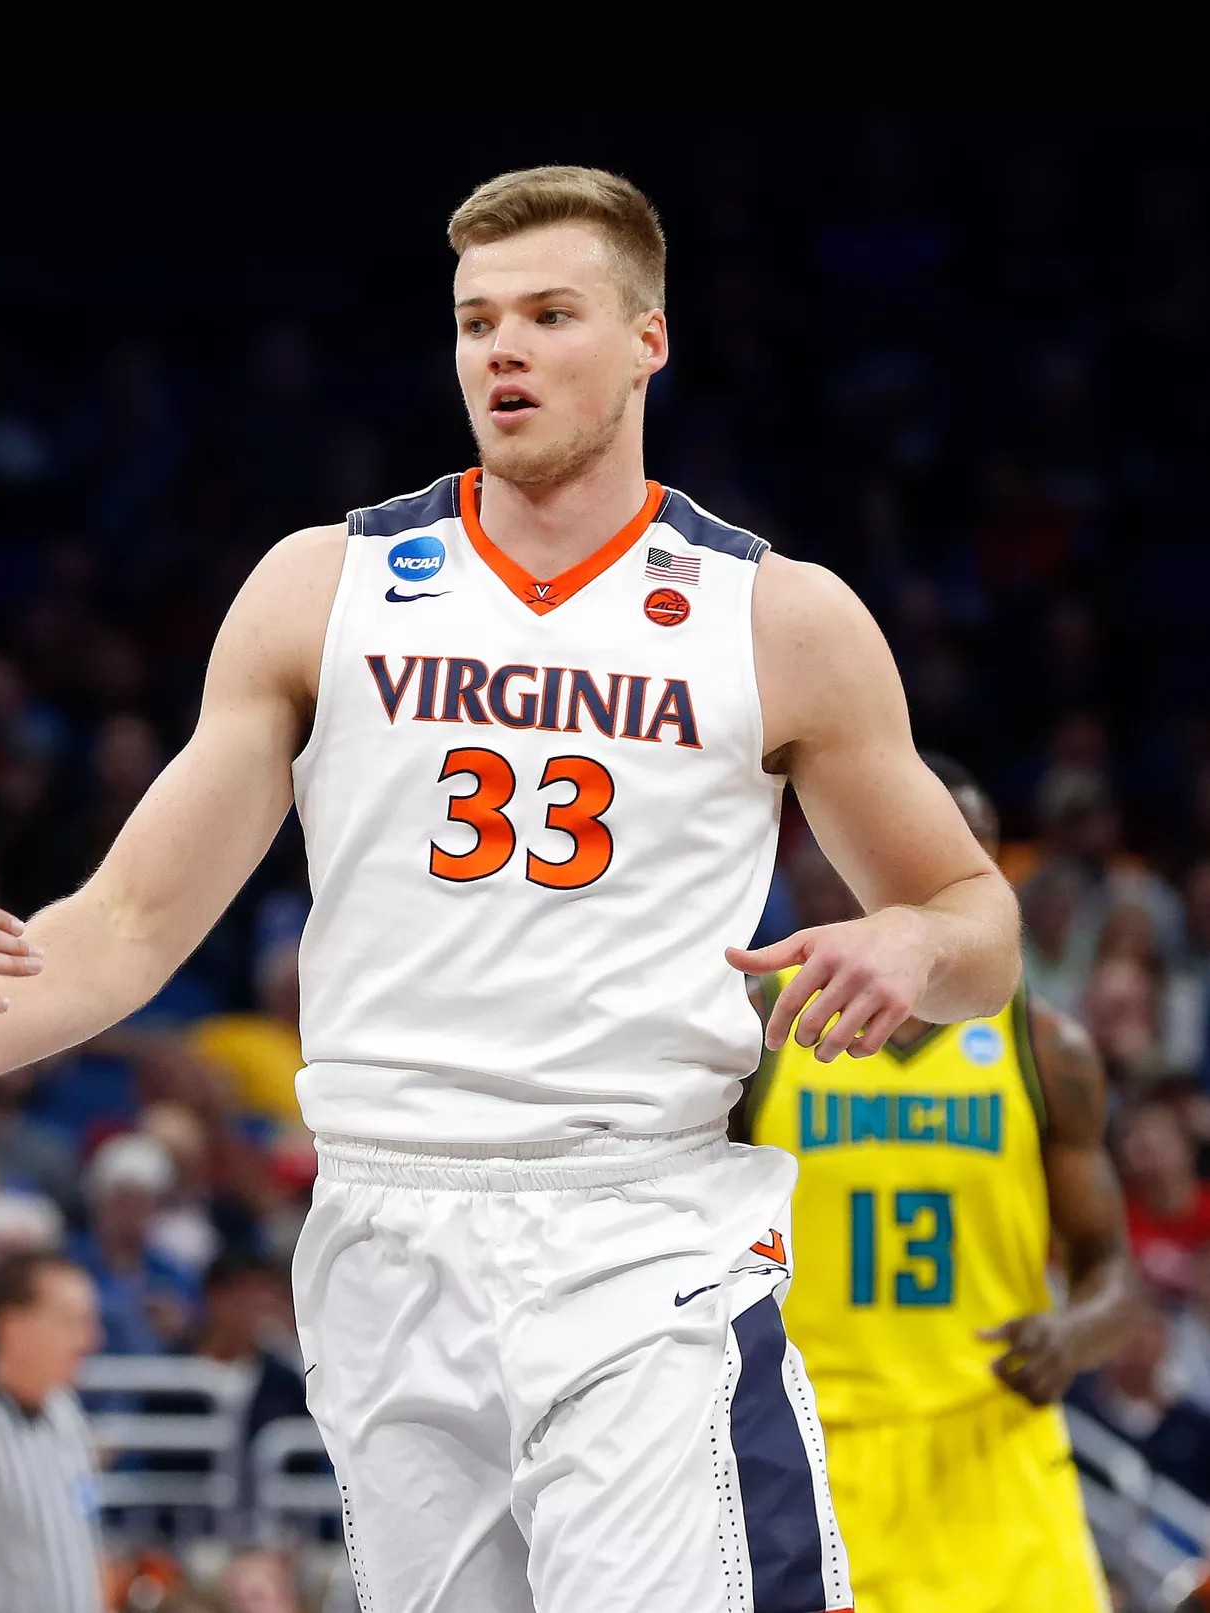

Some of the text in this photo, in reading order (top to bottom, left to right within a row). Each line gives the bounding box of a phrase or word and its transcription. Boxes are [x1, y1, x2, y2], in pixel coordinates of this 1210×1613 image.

[392, 555, 441, 570] NCAA
[364, 654, 704, 750] VIRGINIA
[428, 746, 616, 891] 33
[849, 1188, 956, 1309] 13
